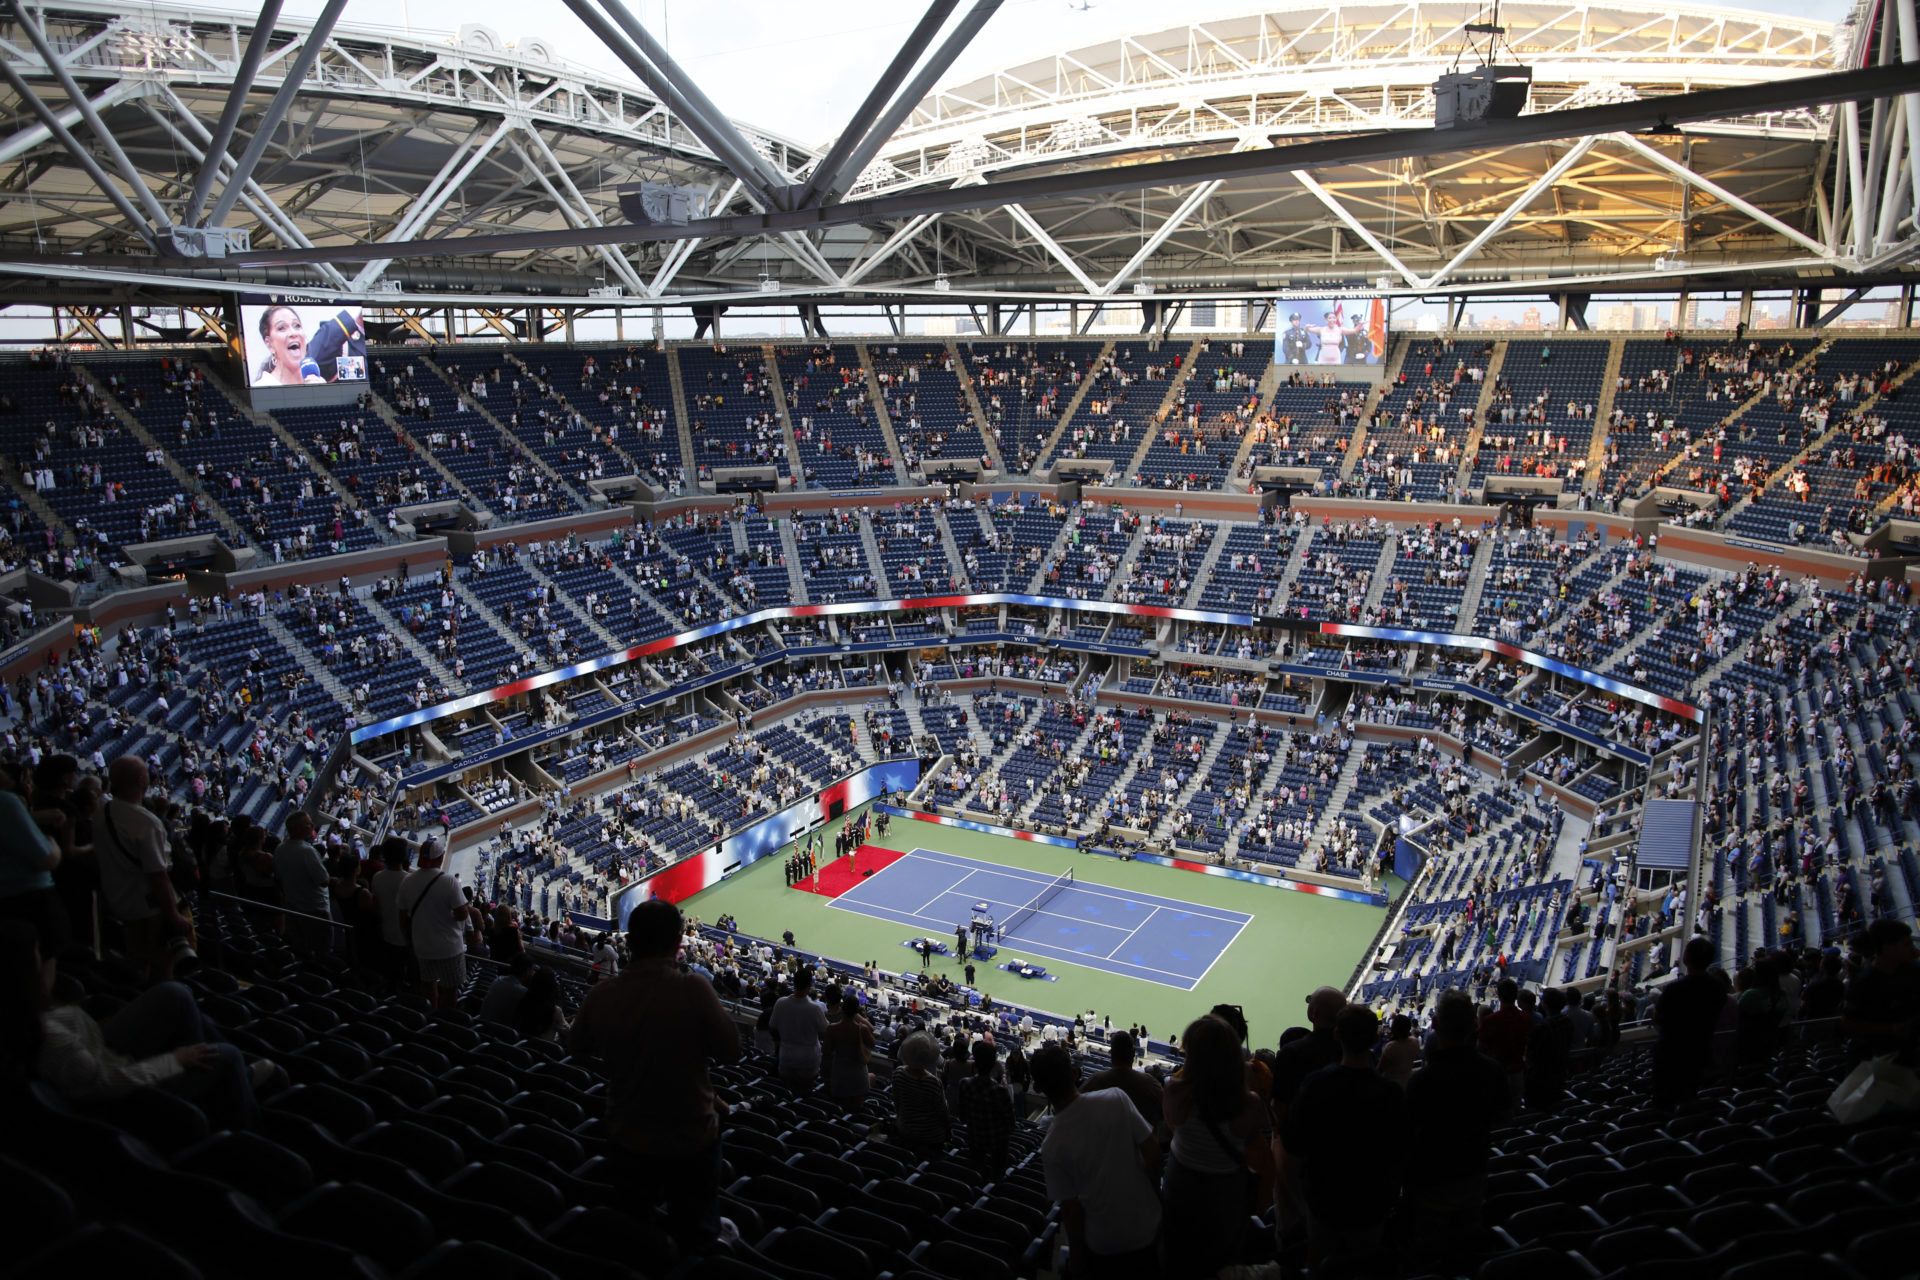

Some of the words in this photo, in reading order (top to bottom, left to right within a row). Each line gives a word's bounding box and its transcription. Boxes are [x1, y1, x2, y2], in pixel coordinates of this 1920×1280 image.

[1326, 670, 1350, 678] CHASE
[1422, 681, 1455, 690] ticketmaster
[546, 726, 569, 738] CHUBB
[452, 753, 489, 770] CADILLAC
